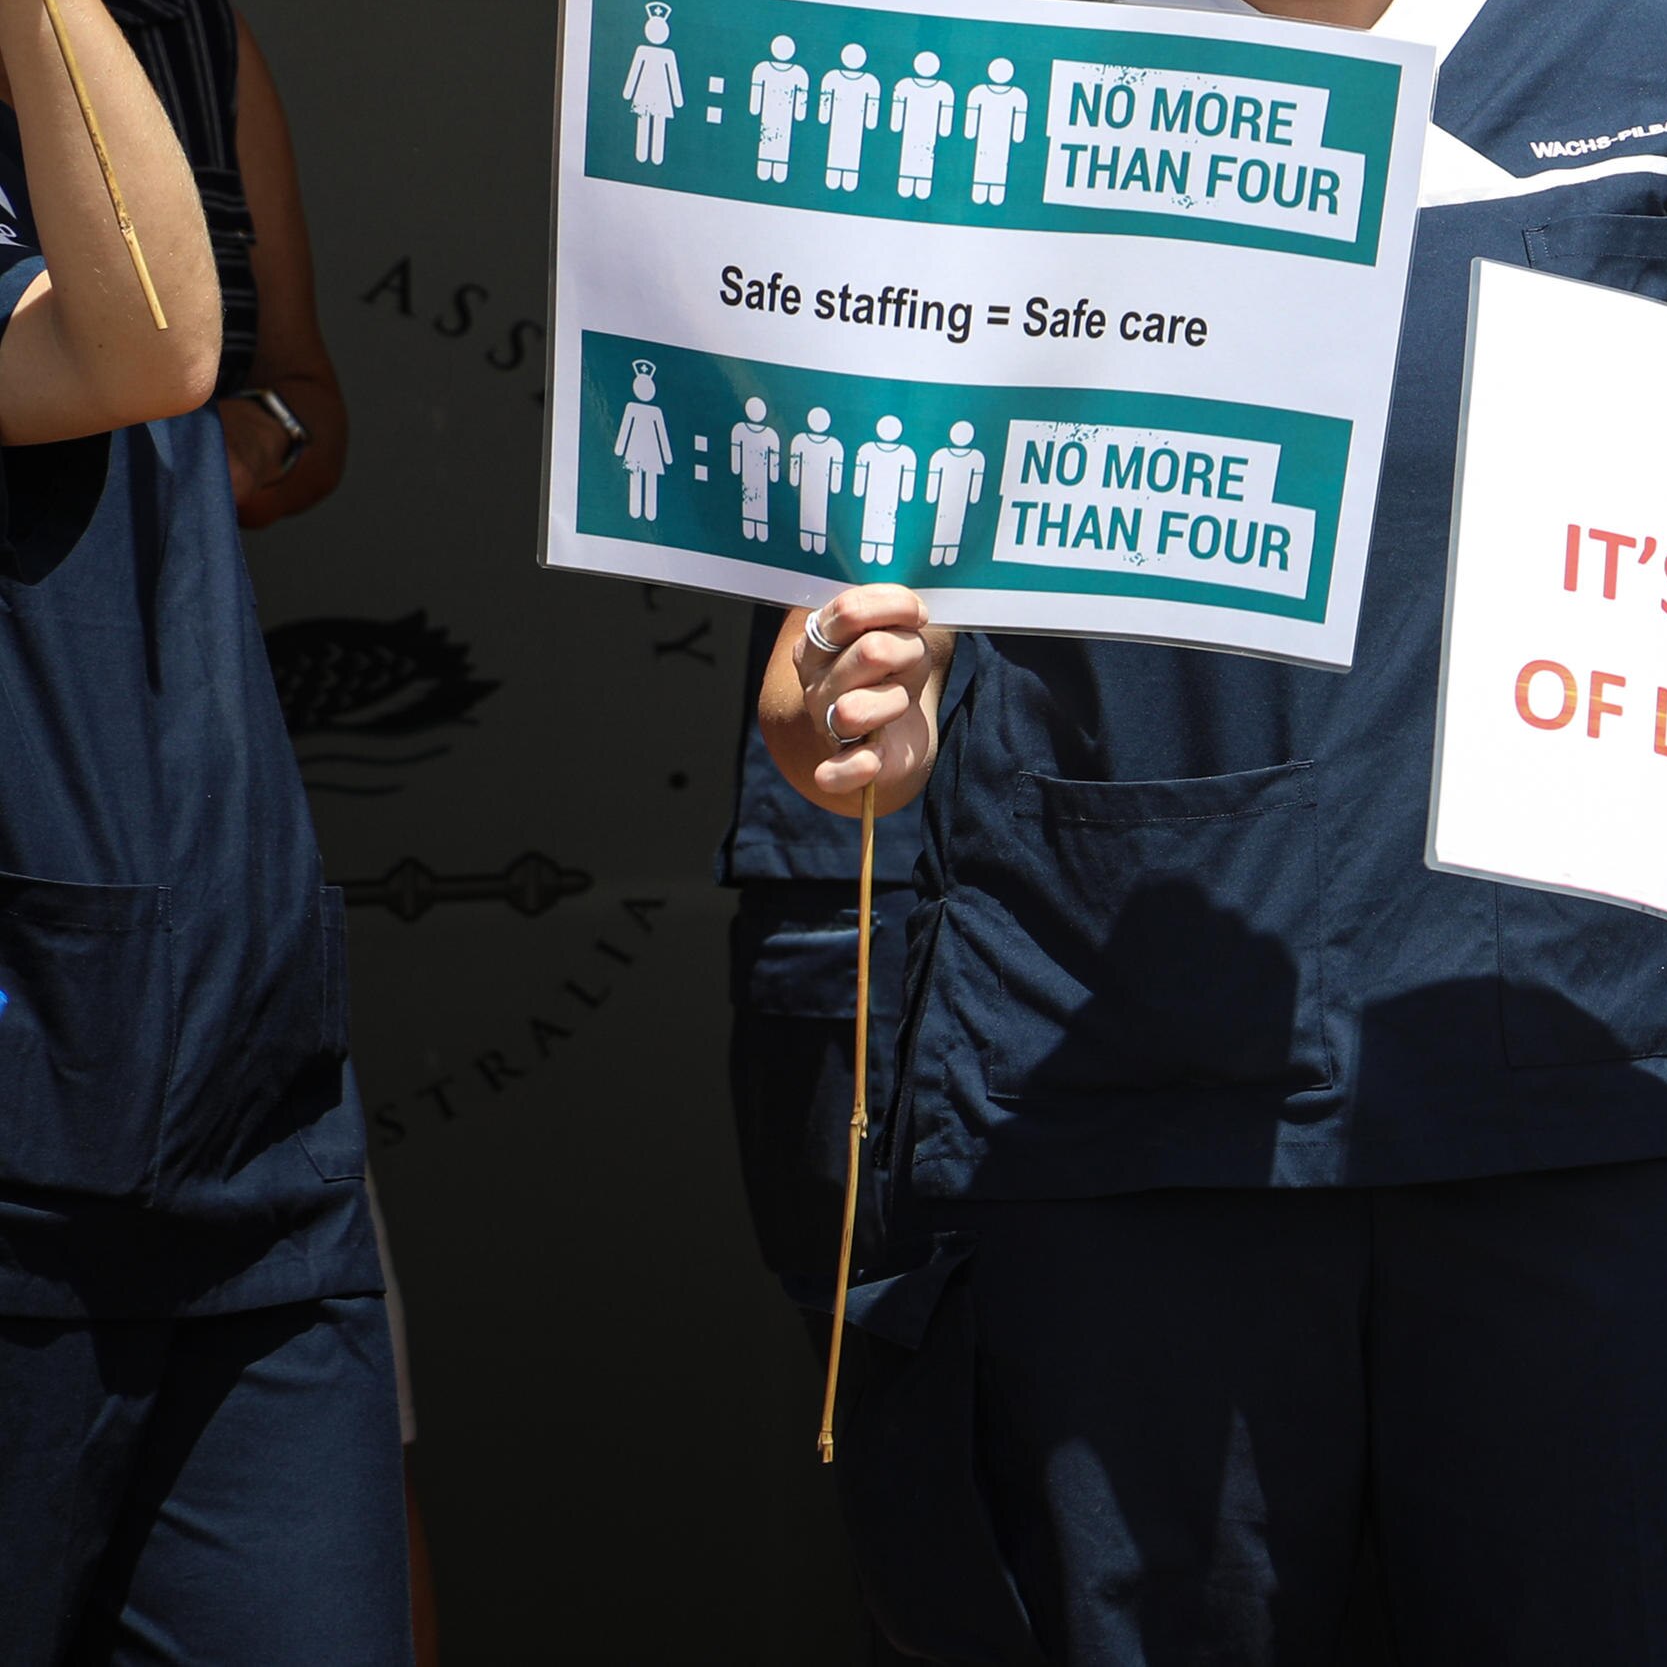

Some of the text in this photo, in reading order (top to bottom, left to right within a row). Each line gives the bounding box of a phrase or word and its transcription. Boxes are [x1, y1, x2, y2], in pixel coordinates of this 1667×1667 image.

[1068, 82, 1299, 146] NO MORE
[1060, 143, 1342, 216] THAN FOUR
[719, 264, 802, 317] Safe
[813, 284, 974, 343] staffing
[1022, 296, 1108, 340] Safe
[1118, 310, 1209, 348] care
[1019, 440, 1249, 503] NO MORE
[1010, 502, 1293, 571] THAN FOUR
[1513, 659, 1628, 740] OF
